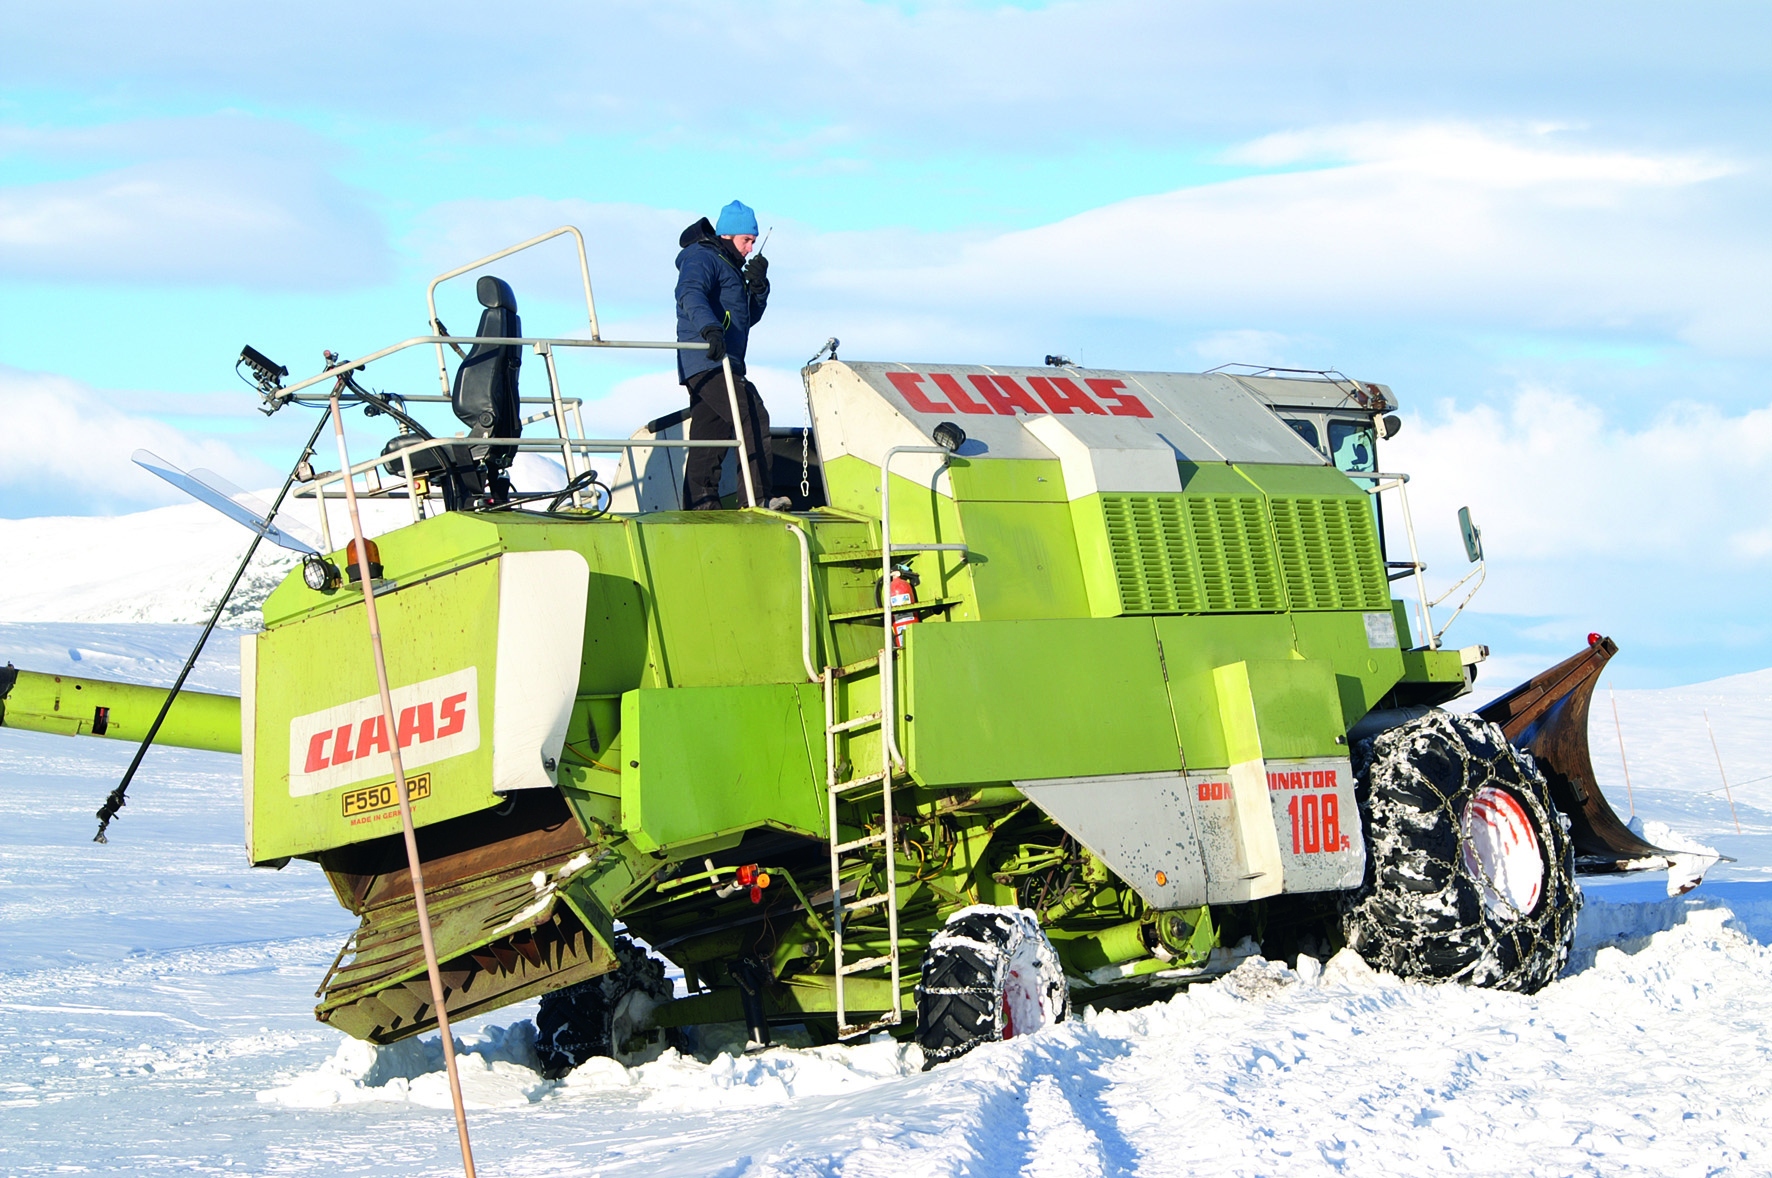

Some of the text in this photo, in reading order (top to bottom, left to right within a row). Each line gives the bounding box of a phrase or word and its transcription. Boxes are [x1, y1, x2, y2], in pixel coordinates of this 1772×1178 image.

[885, 372, 1154, 418] CLAAS
[304, 692, 467, 773] CLAAS
[345, 777, 428, 813] F550 PR
[350, 806, 417, 826] MADE IN GERMY
